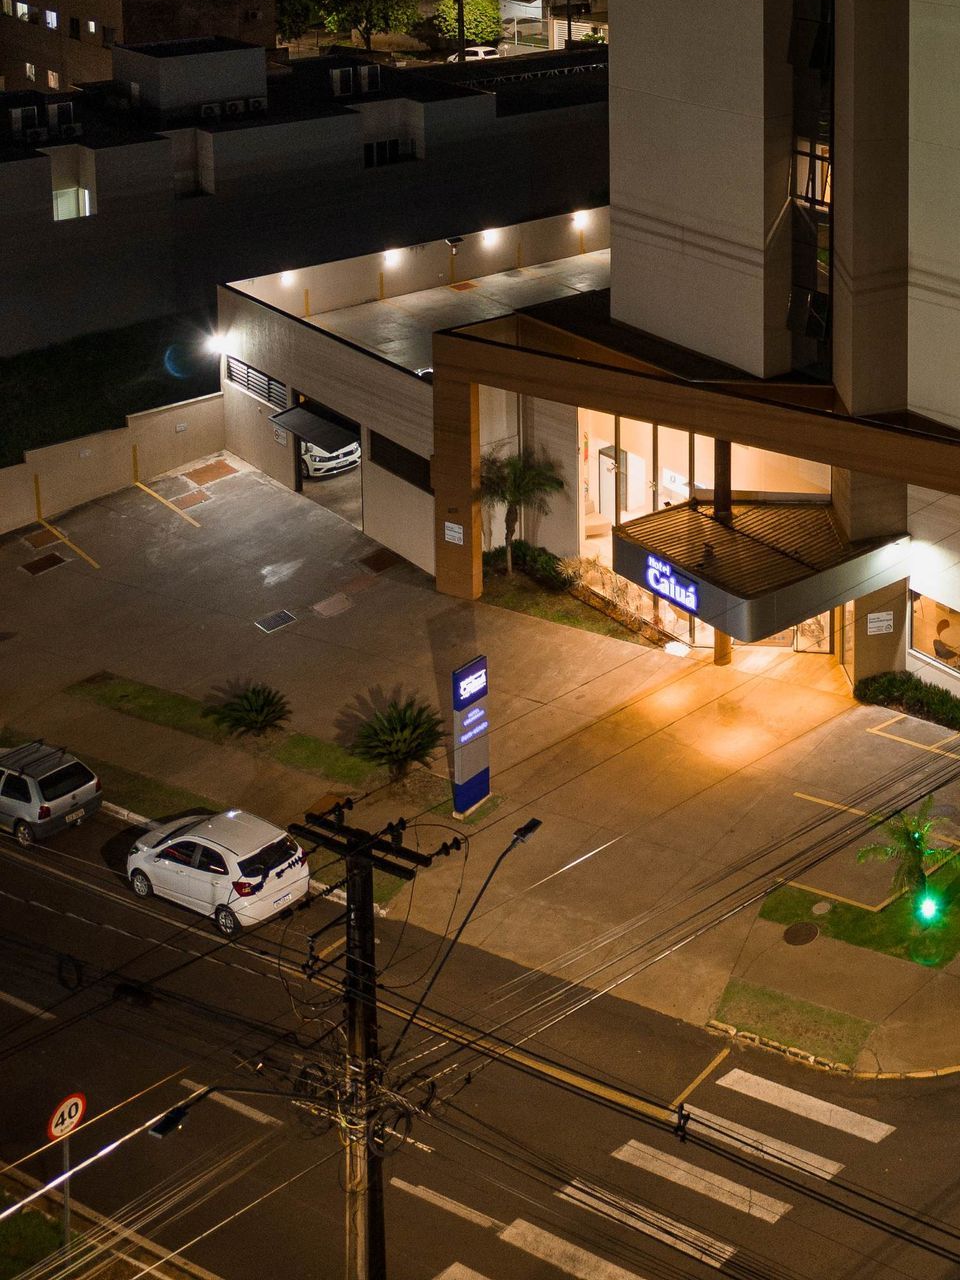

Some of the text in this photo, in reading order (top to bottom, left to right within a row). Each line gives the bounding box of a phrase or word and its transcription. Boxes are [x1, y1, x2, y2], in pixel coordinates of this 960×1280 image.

[648, 555, 671, 576] Hotel
[648, 568, 696, 610] Caiuá
[54, 1102, 79, 1129] 40
